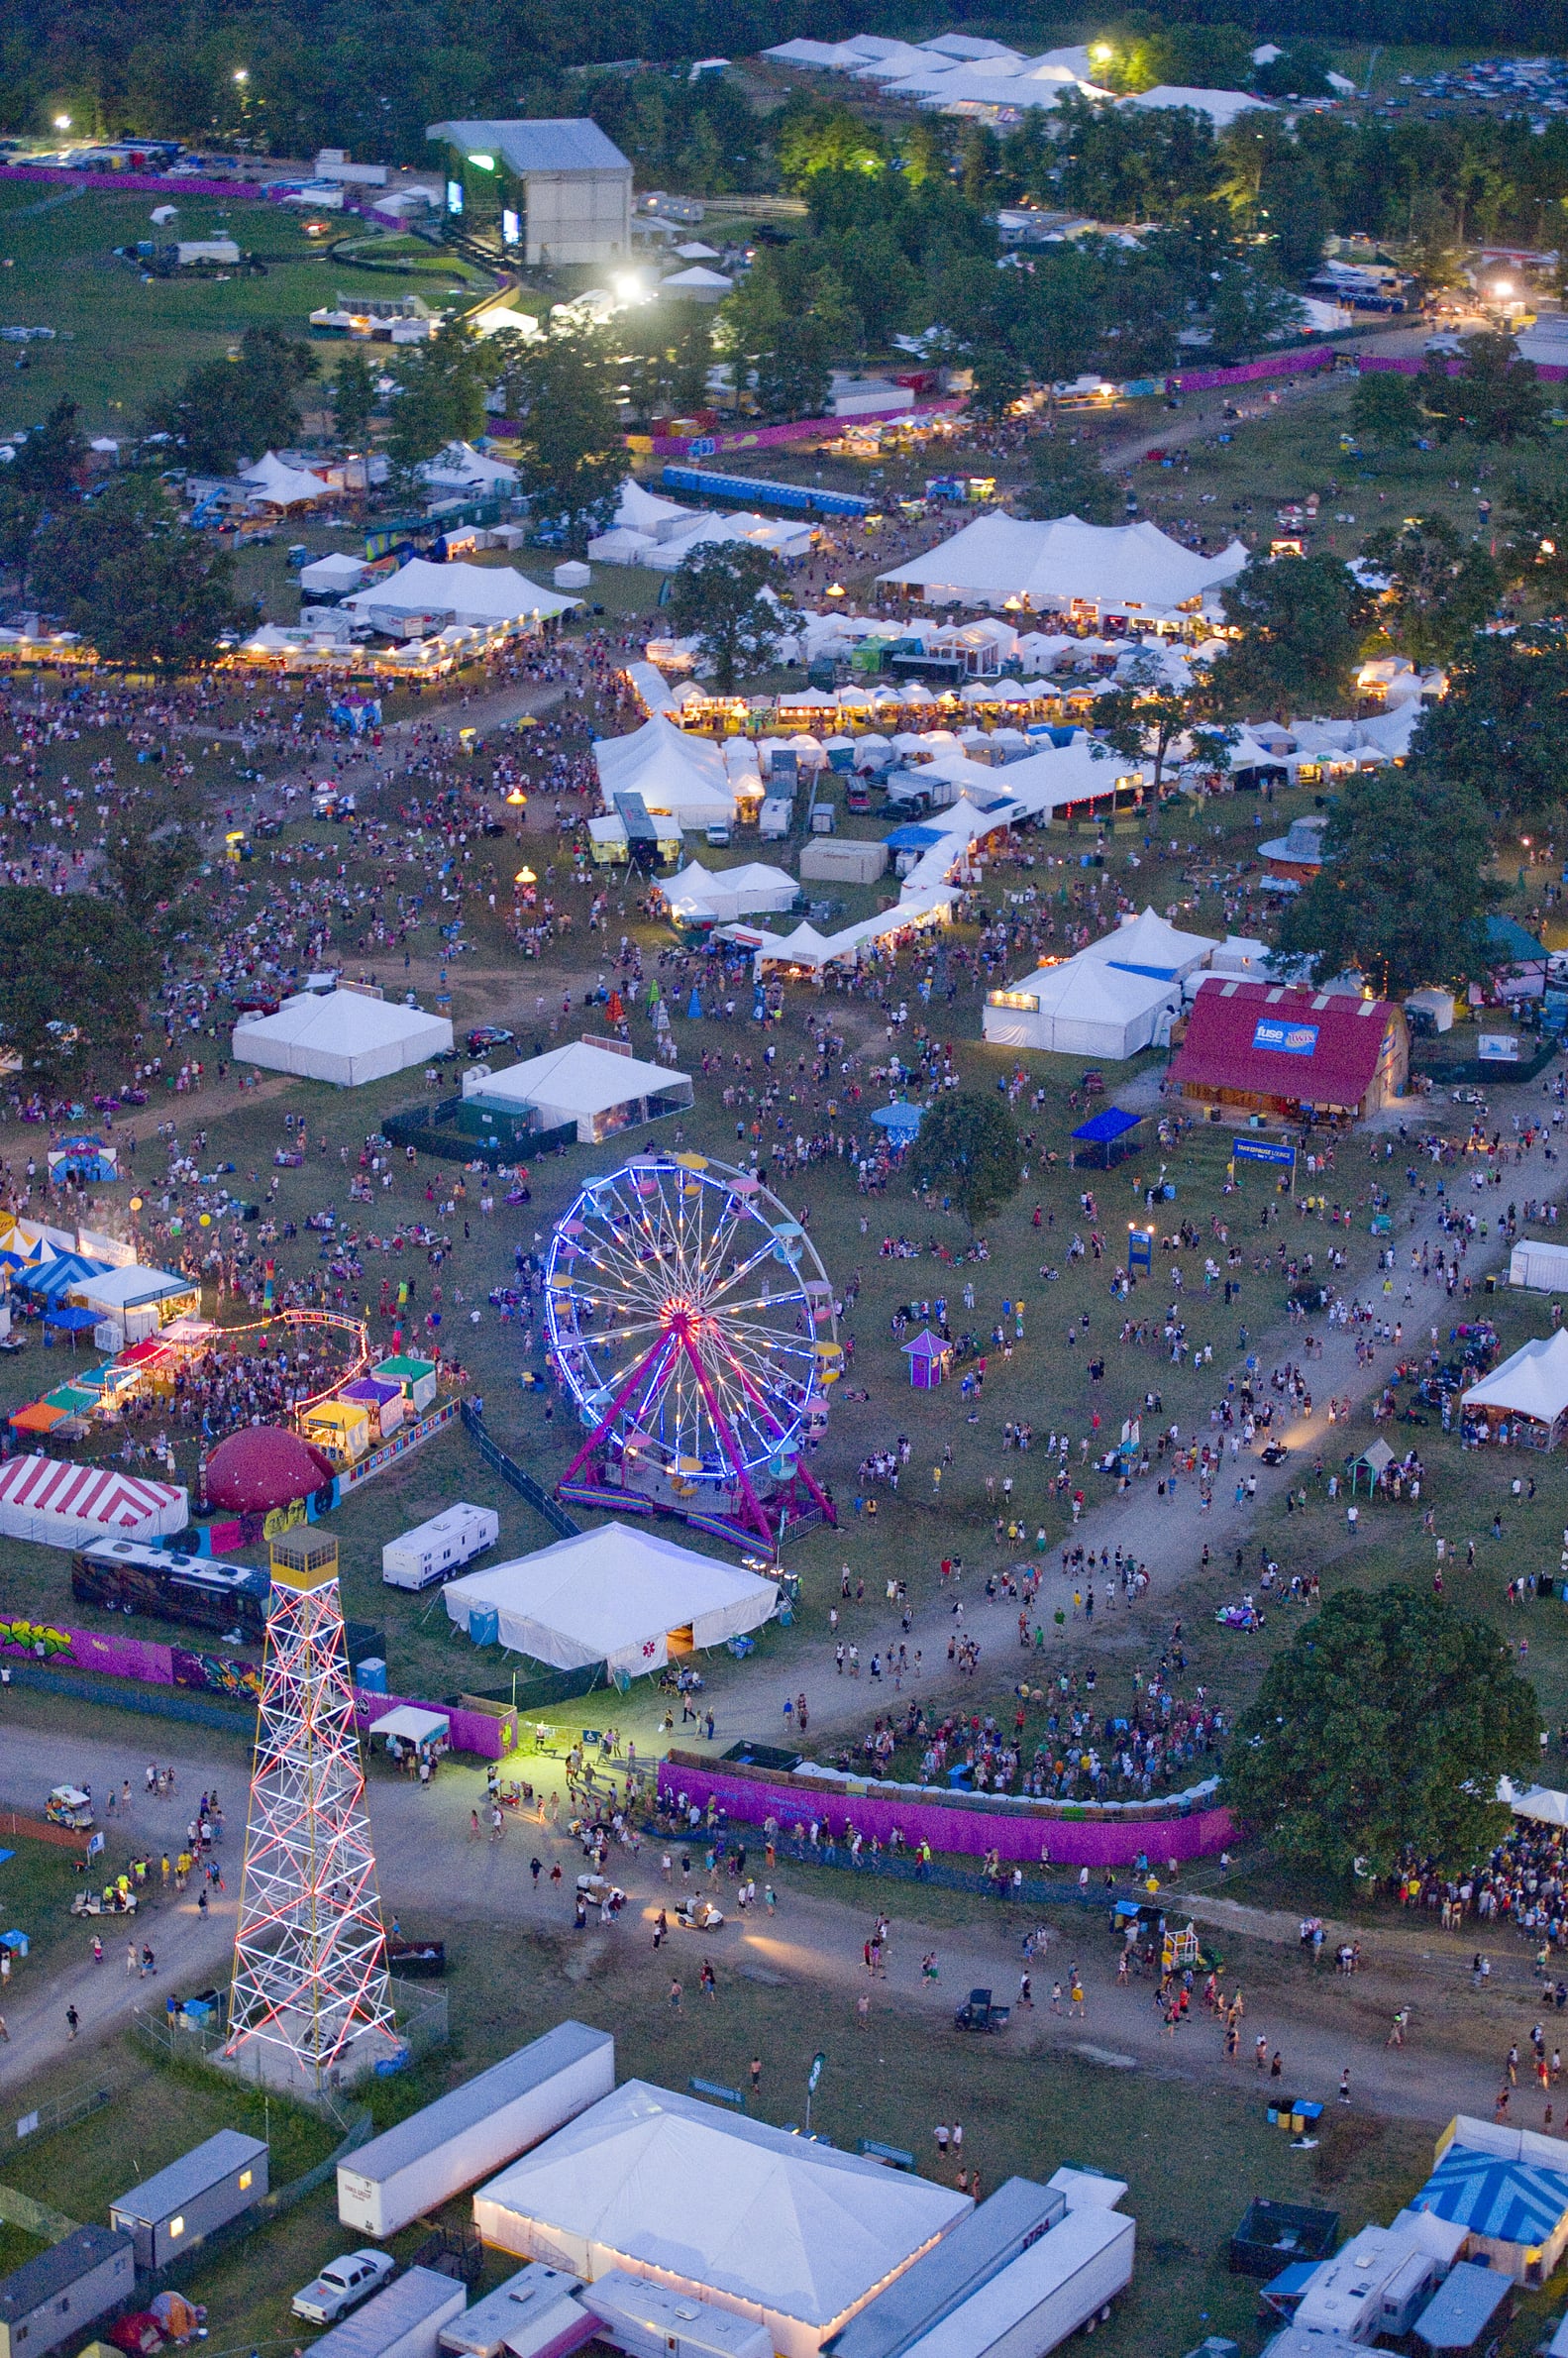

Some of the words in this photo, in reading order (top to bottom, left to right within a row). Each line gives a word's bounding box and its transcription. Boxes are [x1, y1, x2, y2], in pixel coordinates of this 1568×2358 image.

[1257, 1025, 1284, 1039] fuse
[1271, 1150, 1291, 1159] LOUNGE
[369, 1438, 403, 1468] ADULT
